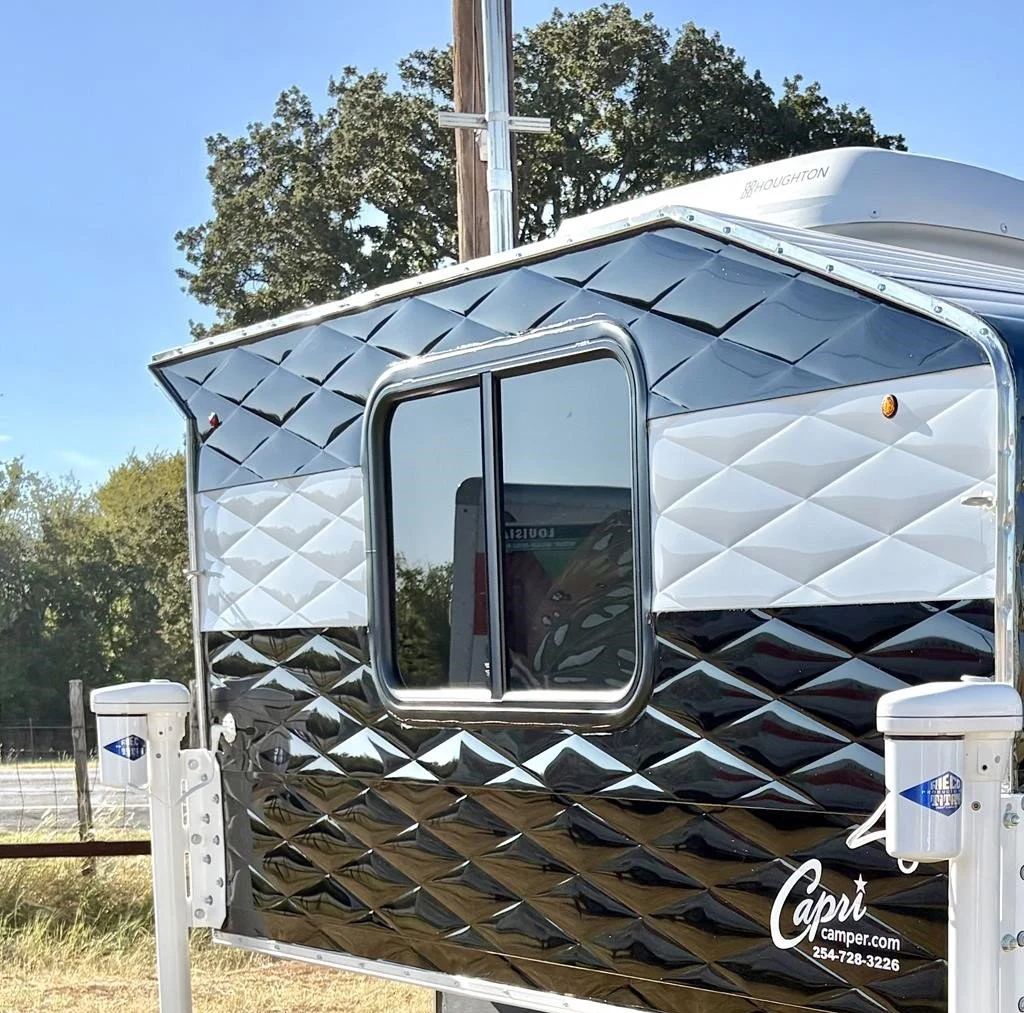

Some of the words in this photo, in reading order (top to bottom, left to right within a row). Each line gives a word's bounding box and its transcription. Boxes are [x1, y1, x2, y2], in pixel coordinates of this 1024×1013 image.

[753, 166, 831, 192] HOUGHTON
[769, 858, 868, 950] Capri
[820, 927, 901, 951] camper.com
[812, 945, 901, 972] 254-728-3226
